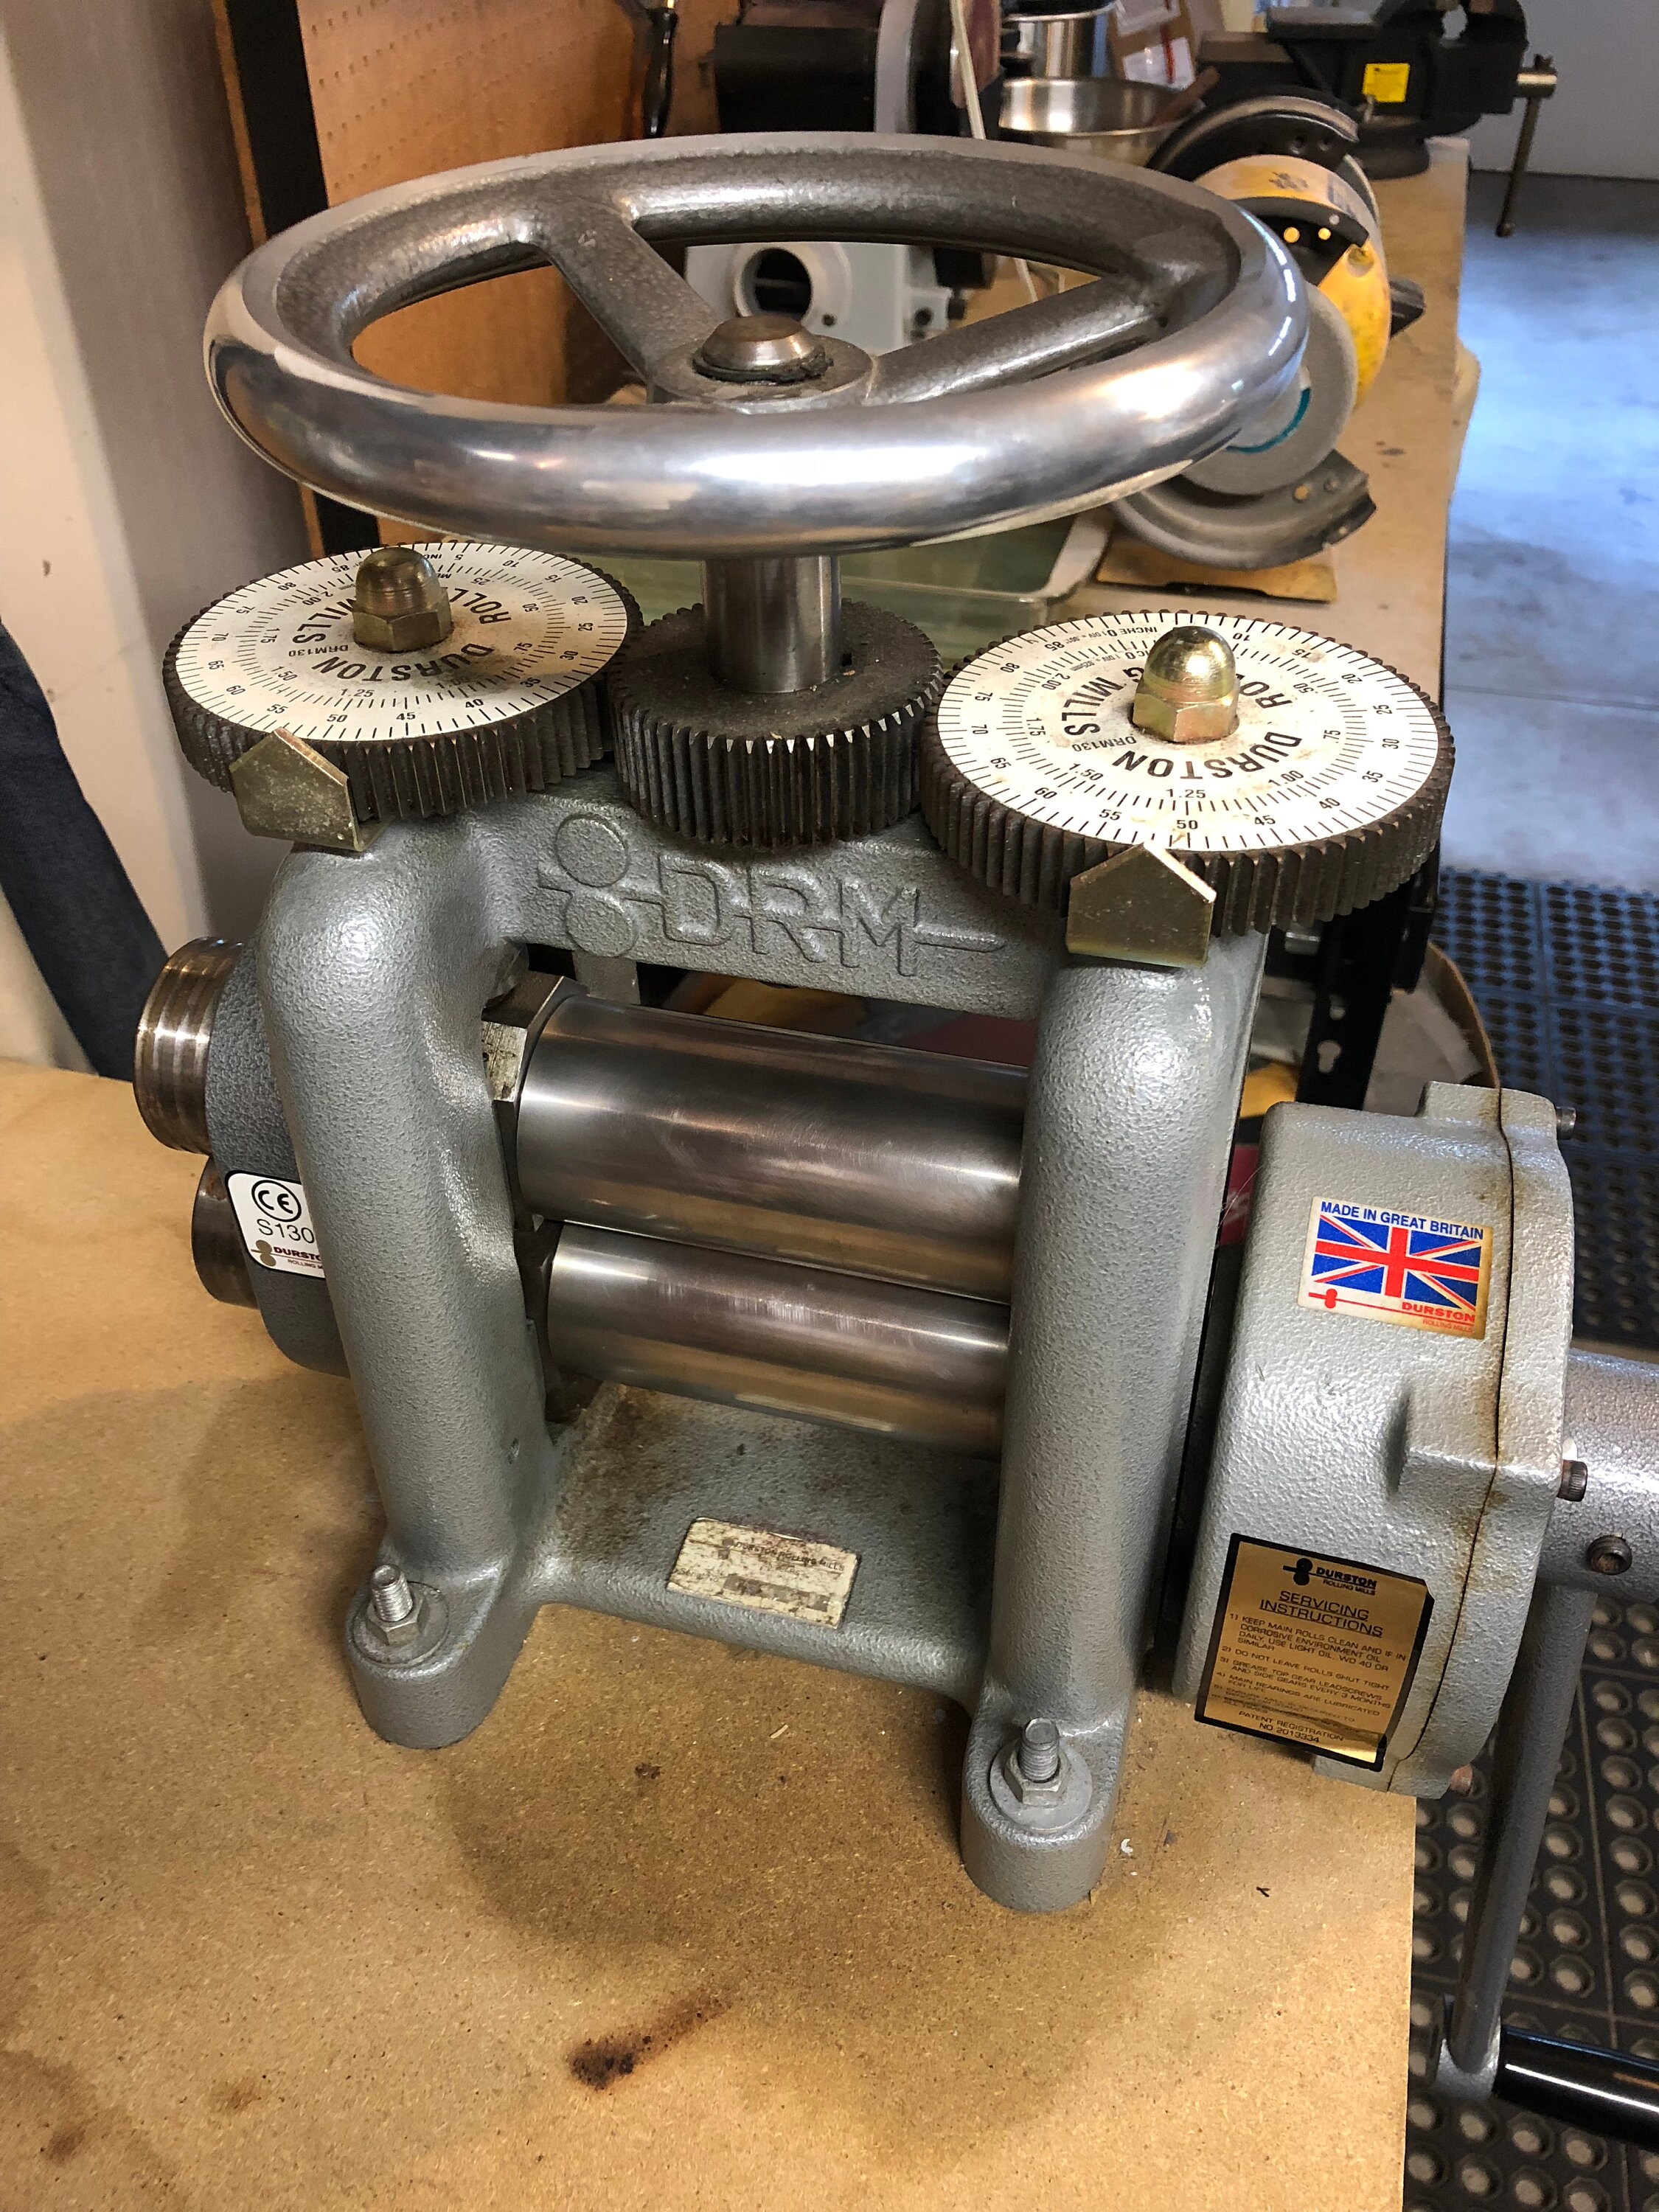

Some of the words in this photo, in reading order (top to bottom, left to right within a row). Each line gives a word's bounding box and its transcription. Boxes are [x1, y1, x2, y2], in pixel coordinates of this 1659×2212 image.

[332, 565, 349, 573] 85
[502, 560, 519, 568] 10
[544, 574, 563, 583] 15
[277, 582, 296, 591] 80
[302, 591, 334, 605] 2.00
[571, 596, 588, 605] 20
[236, 605, 255, 614] 75
[577, 622, 594, 631] 25
[212, 633, 229, 641] 70
[260, 627, 280, 644] 1.75
[1233, 633, 1251, 641] 10
[288, 644, 349, 657] DRM130
[1044, 641, 1065, 651] 85
[559, 650, 579, 661] 30
[1293, 648, 1311, 658] 15
[208, 660, 224, 670] 65
[312, 644, 495, 681] DURSTON
[1001, 663, 1020, 673] 80
[271, 666, 298, 681] 1.50
[1341, 673, 1363, 684] 20
[520, 677, 540, 687] 35
[1041, 673, 1071, 689] 2.00
[226, 685, 246, 695] 60
[341, 688, 375, 698] 1.25
[975, 692, 993, 701] 75
[266, 703, 288, 714] 55
[465, 699, 484, 709] 40
[1061, 677, 1124, 736] MILLS
[1373, 704, 1393, 715] 25
[327, 714, 348, 723] 50
[396, 712, 416, 720] 45
[971, 724, 989, 734] 70
[1026, 717, 1046, 736] 1.75
[1072, 736, 1136, 752] DRM130
[1382, 739, 1399, 749] 30
[1112, 731, 1302, 779] DURSTON
[990, 757, 1011, 769] 65
[1069, 762, 1104, 781] 1.50
[1362, 771, 1383, 782] 35
[1268, 770, 1304, 786] 1.00
[1034, 787, 1057, 799] 60
[1166, 789, 1206, 799] 1.25
[1319, 798, 1340, 809] 40
[1099, 809, 1123, 821] 55
[1253, 815, 1276, 826] 45
[1177, 819, 1198, 830] 50
[658, 850, 920, 978] DRM
[1321, 1201, 1359, 1217] MADE
[1363, 1208, 1377, 1220] IN
[1380, 1211, 1426, 1230] GREAT
[1430, 1220, 1484, 1239] BRITAIN
[257, 1219, 315, 1244] S130
[274, 1246, 322, 1261] DURSTO
[1402, 1301, 1475, 1323] DURSTON
[1422, 1318, 1452, 1330] ROLLING
[1453, 1324, 1474, 1333] MILLS
[1316, 1567, 1377, 1587] DURSTON
[1323, 1579, 1353, 1590] ROLLING
[1355, 1586, 1375, 1596] MILLS
[1279, 1590, 1369, 1621] SERVICING
[1260, 1599, 1383, 1636] INSTRUCTIONS
[1237, 1638, 1275, 1651] SIMILAR
[1240, 1624, 1293, 1641] CORROSIVE
[1295, 1638, 1363, 1658] ENVIRONMENT
[1366, 1654, 1380, 1663] OIL
[1242, 1616, 1265, 1626] KEEP
[1268, 1622, 1293, 1633] MAIN
[1295, 1629, 1325, 1641] ROLLS
[1327, 1636, 1358, 1649] CLEAN
[1361, 1645, 1382, 1655] AND
[1396, 1653, 1406, 1661] IN
[1268, 1638, 1287, 1647] USE
[1290, 1643, 1316, 1654] LIGHT
[1339, 1655, 1356, 1664] WD
[1359, 1660, 1371, 1669] 40
[1374, 1663, 1389, 1672] OR
[1235, 1649, 1248, 1657] DO
[1251, 1653, 1270, 1662] NOT
[1273, 1658, 1300, 1669] LEAVE
[1304, 1666, 1333, 1677] ROLLS
[1335, 1673, 1360, 1683] SHUT
[1363, 1680, 1390, 1691] TIGHT
[1232, 1660, 1267, 1672] GREASE
[1272, 1669, 1289, 1677] TOP
[1291, 1674, 1316, 1683] GEAR
[1319, 1681, 1382, 1700] LEADSCREWS
[1231, 1666, 1251, 1674] AND
[1254, 1671, 1274, 1679] SIDE
[1277, 1677, 1307, 1688] GEARS
[1310, 1685, 1339, 1696] EVERY
[1350, 1694, 1391, 1708] MONTHS
[1229, 1674, 1253, 1684] MAIN
[1256, 1681, 1301, 1697] BEARINGS
[1324, 1699, 1380, 1716] LUBRICATED
[1239, 1711, 1273, 1723] PATENT
[1276, 1719, 1343, 1741] REGISTRATION
[1259, 1723, 1273, 1731] NO
[1276, 1728, 1320, 1743] 2013334
